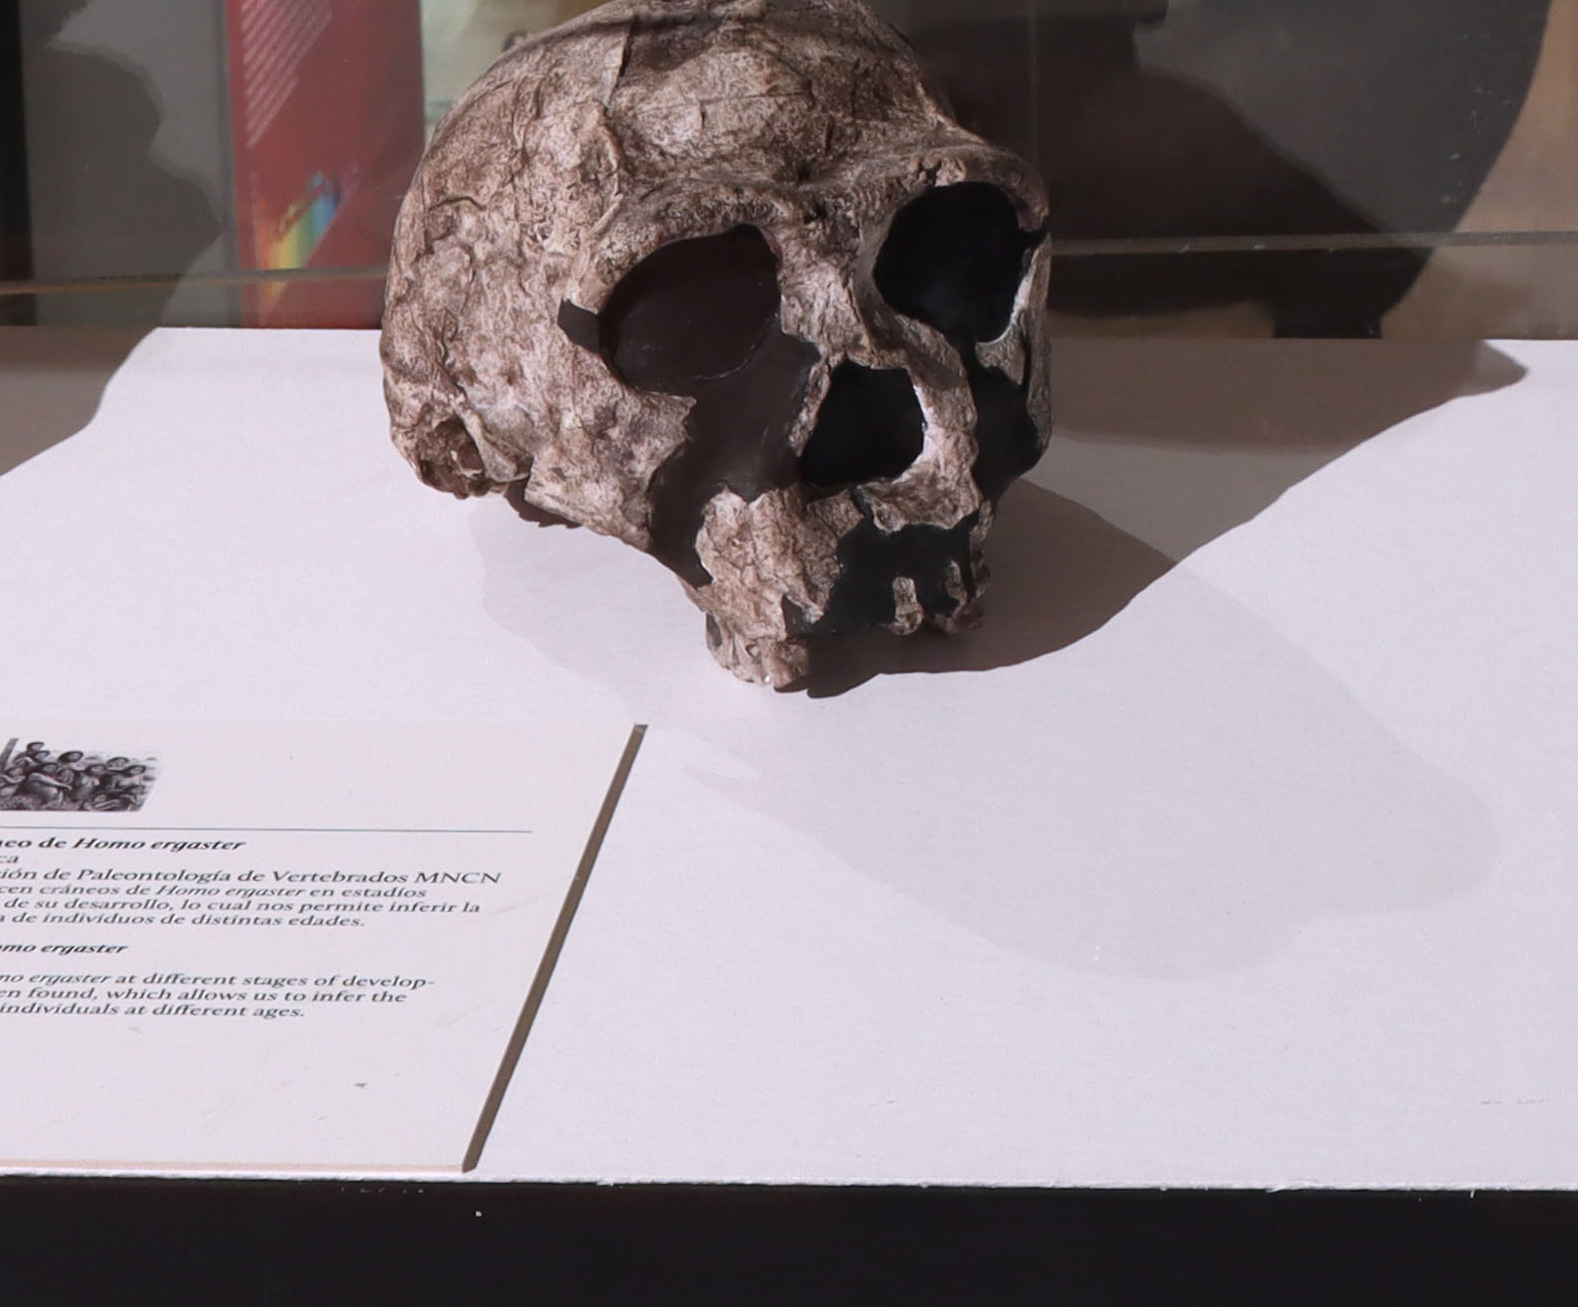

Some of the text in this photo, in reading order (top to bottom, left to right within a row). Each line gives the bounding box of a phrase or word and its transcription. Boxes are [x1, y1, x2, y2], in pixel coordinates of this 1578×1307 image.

[37, 837, 67, 849] de
[72, 837, 145, 850] Homo
[150, 838, 243, 853] ergaster
[42, 868, 70, 880] de
[77, 869, 230, 884] Paleontología
[236, 869, 264, 882] de
[273, 870, 407, 883] Vertebrados
[415, 871, 500, 884] MNCN
[3, 897, 28, 909] de
[36, 901, 58, 910] su
[64, 898, 172, 912] desarrollo,
[180, 898, 201, 911] lo
[206, 899, 251, 911] cual
[256, 902, 292, 911] nos
[298, 899, 382, 914] permite
[389, 900, 455, 913] inferir
[462, 901, 480, 913] la
[40, 941, 126, 956] ergaster
[28, 971, 109, 986] ergaster
[114, 972, 135, 984] at
[142, 972, 235, 985] different
[243, 973, 306, 988] stages
[313, 973, 336, 986] of
[341, 974, 435, 988] develop-
